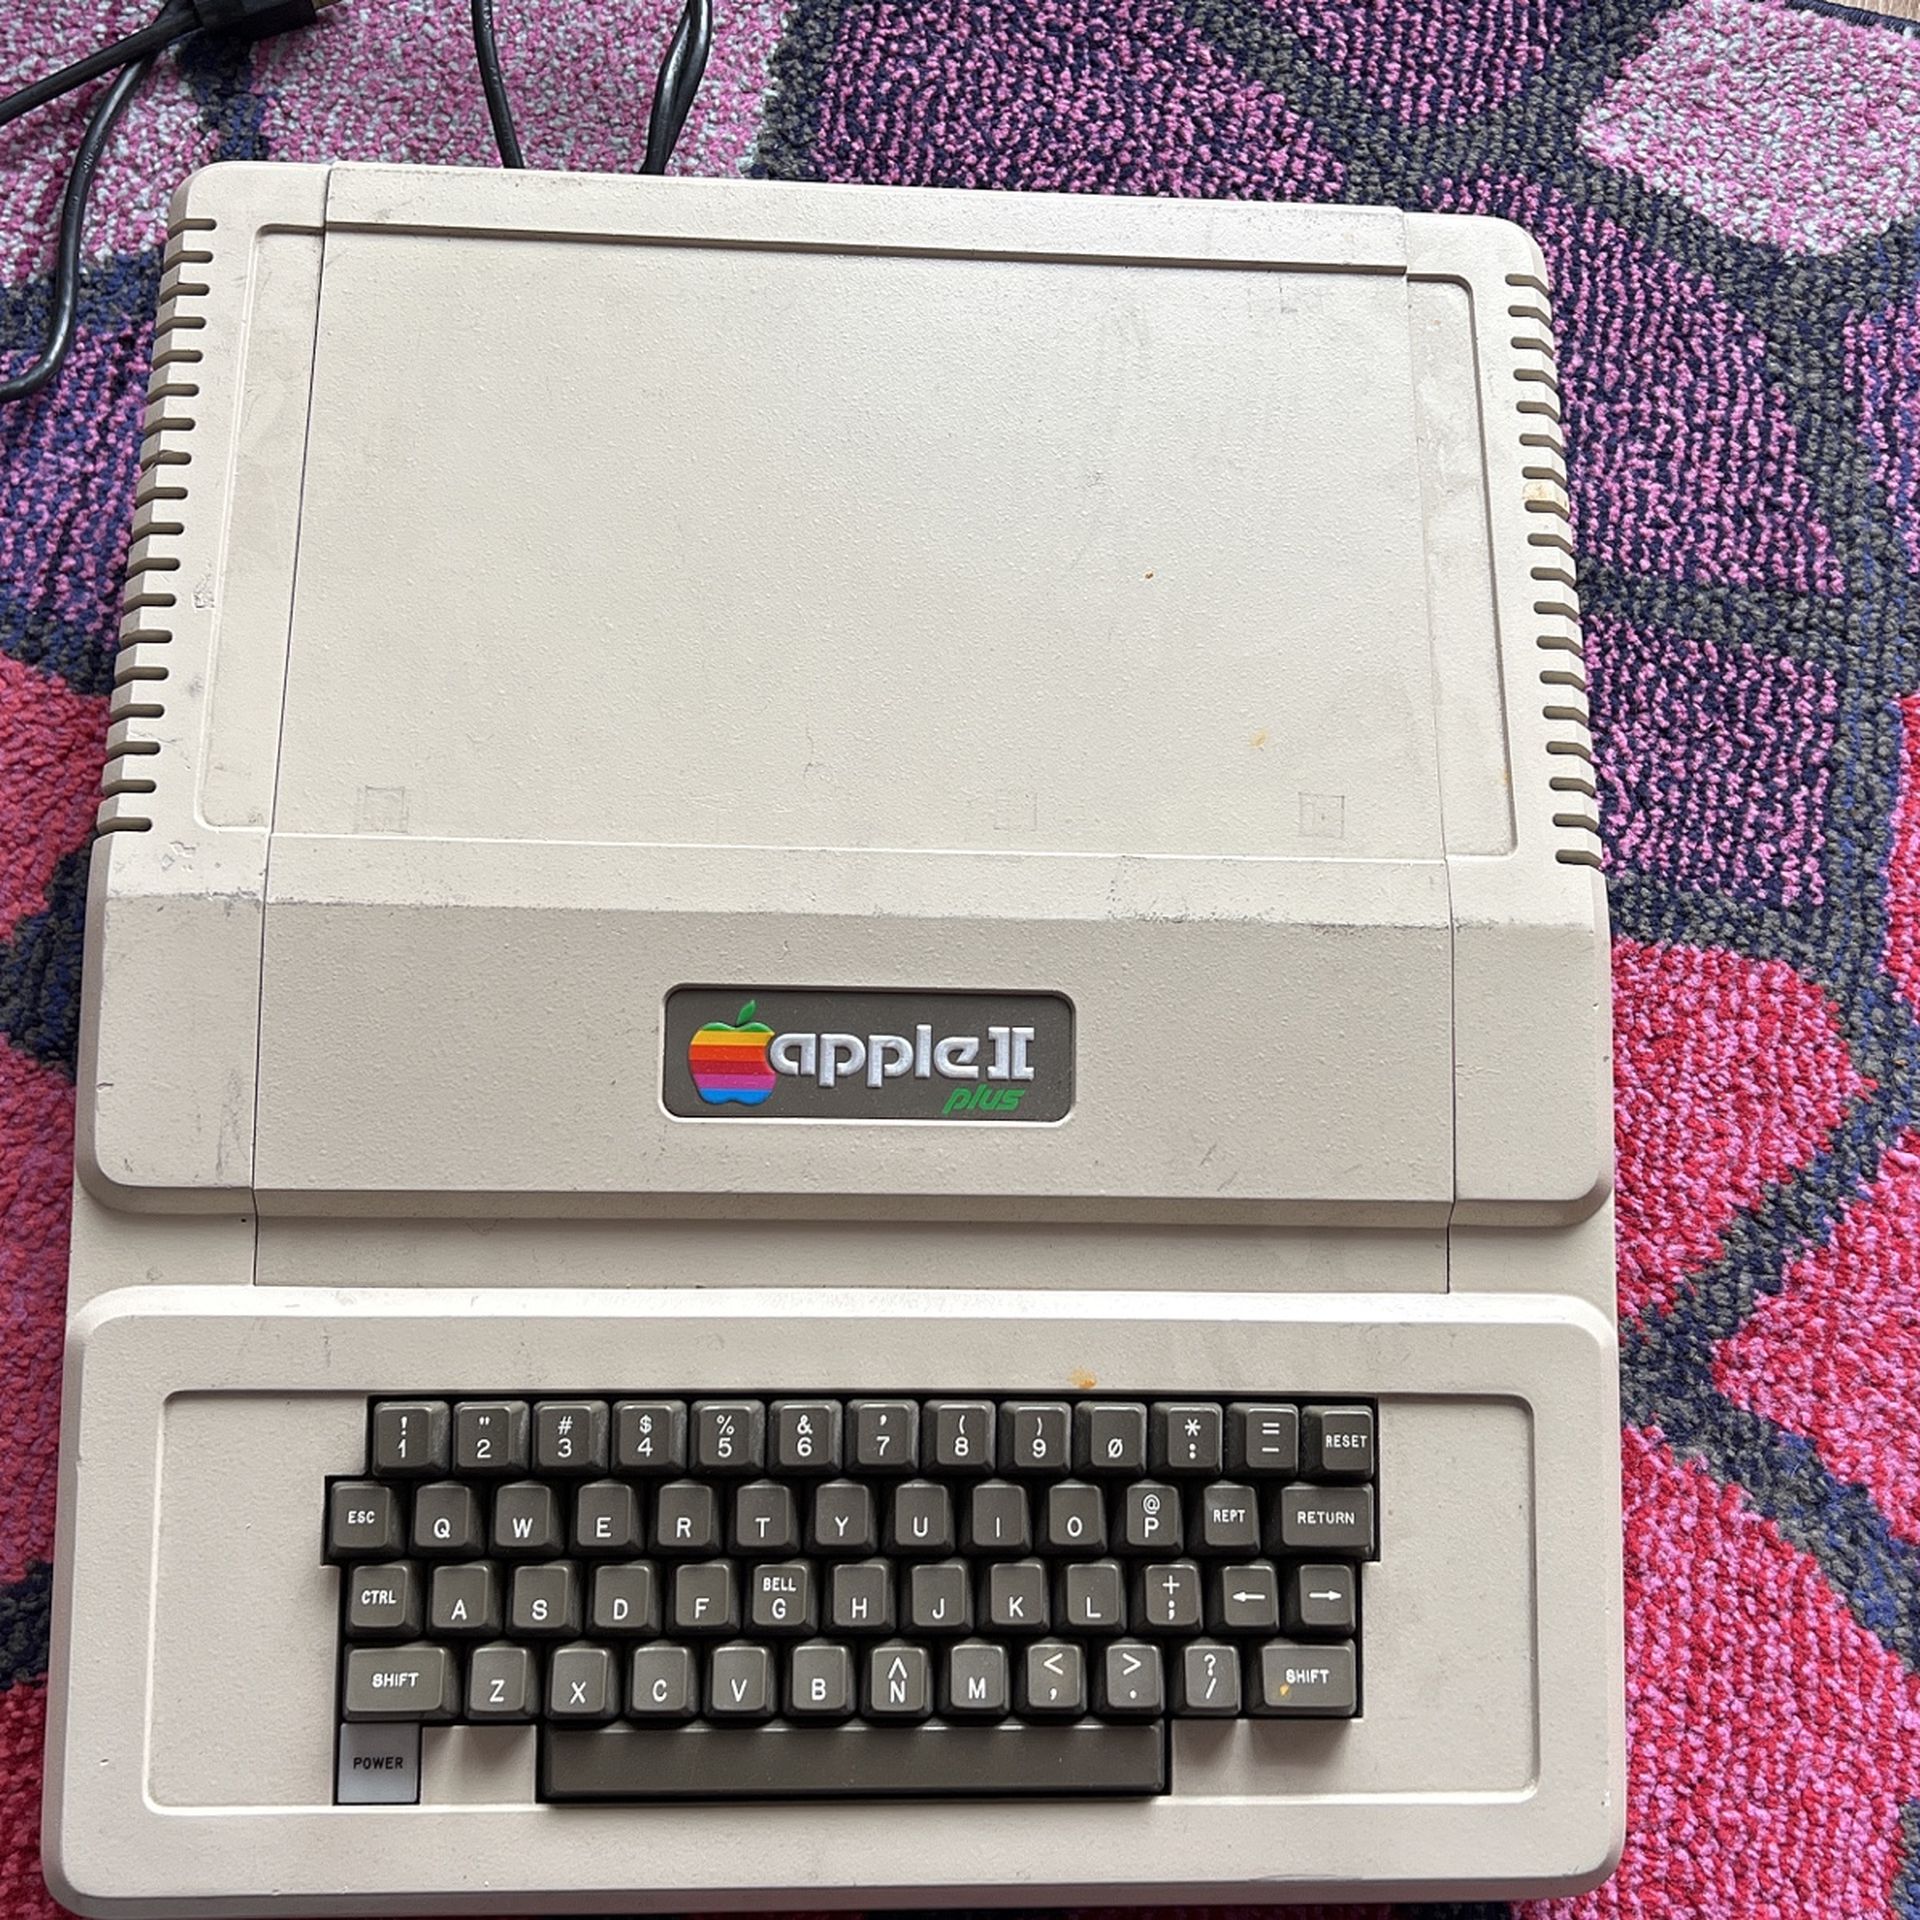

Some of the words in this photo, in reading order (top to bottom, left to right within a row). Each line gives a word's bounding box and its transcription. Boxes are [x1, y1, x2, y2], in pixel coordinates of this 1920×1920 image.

[770, 1024, 979, 1087] apple
[943, 1085, 1025, 1113] plus
[401, 1416, 408, 1436] !
[557, 1415, 573, 1435] #
[639, 1414, 652, 1435] $
[716, 1414, 735, 1435] %
[796, 1414, 813, 1435] &
[958, 1414, 965, 1435] (
[1036, 1417, 1043, 1436] )
[398, 1438, 406, 1458] 1
[476, 1438, 492, 1459] 2
[557, 1437, 572, 1458] 3
[637, 1437, 654, 1457] 4
[717, 1437, 733, 1458] 5
[797, 1436, 812, 1457] 6
[876, 1435, 890, 1456] 7
[954, 1436, 969, 1457] 8
[1032, 1438, 1047, 1458] 9
[1189, 1443, 1196, 1460] :
[1325, 1434, 1368, 1448] RESET
[1143, 1494, 1161, 1515] @
[347, 1510, 375, 1524] ESC
[834, 1516, 849, 1537] Y
[1067, 1516, 1083, 1537] O
[1213, 1509, 1246, 1523] REPT
[1297, 1510, 1355, 1525] RETURN
[433, 1518, 451, 1539] Q
[512, 1517, 533, 1539] W
[596, 1517, 612, 1538] E
[676, 1517, 692, 1538] R
[755, 1517, 771, 1538] T
[913, 1516, 928, 1538] U
[1144, 1516, 1159, 1538] P
[763, 1576, 797, 1592] BELL
[1162, 1575, 1181, 1595] +
[361, 1589, 397, 1605] CTRL
[1009, 1596, 1024, 1618] K
[1086, 1596, 1102, 1618] L
[451, 1598, 468, 1620] A
[531, 1599, 548, 1621] S
[613, 1598, 629, 1620] D
[695, 1597, 710, 1619] F
[771, 1598, 786, 1620] G
[851, 1597, 867, 1619] H
[932, 1598, 945, 1620] J
[1168, 1600, 1175, 1620] ;
[1043, 1653, 1064, 1675] <
[1122, 1652, 1142, 1676] >
[1204, 1653, 1216, 1677] ?
[372, 1672, 420, 1688] SHIFT
[1286, 1668, 1330, 1684] SHIFT
[489, 1679, 505, 1703] Z
[570, 1681, 587, 1704] X
[652, 1679, 668, 1702] C
[731, 1678, 748, 1702] V
[811, 1678, 826, 1701] B
[890, 1680, 905, 1703] N
[968, 1677, 986, 1699] M
[1205, 1677, 1217, 1700] /
[353, 1756, 404, 1770] POWER
